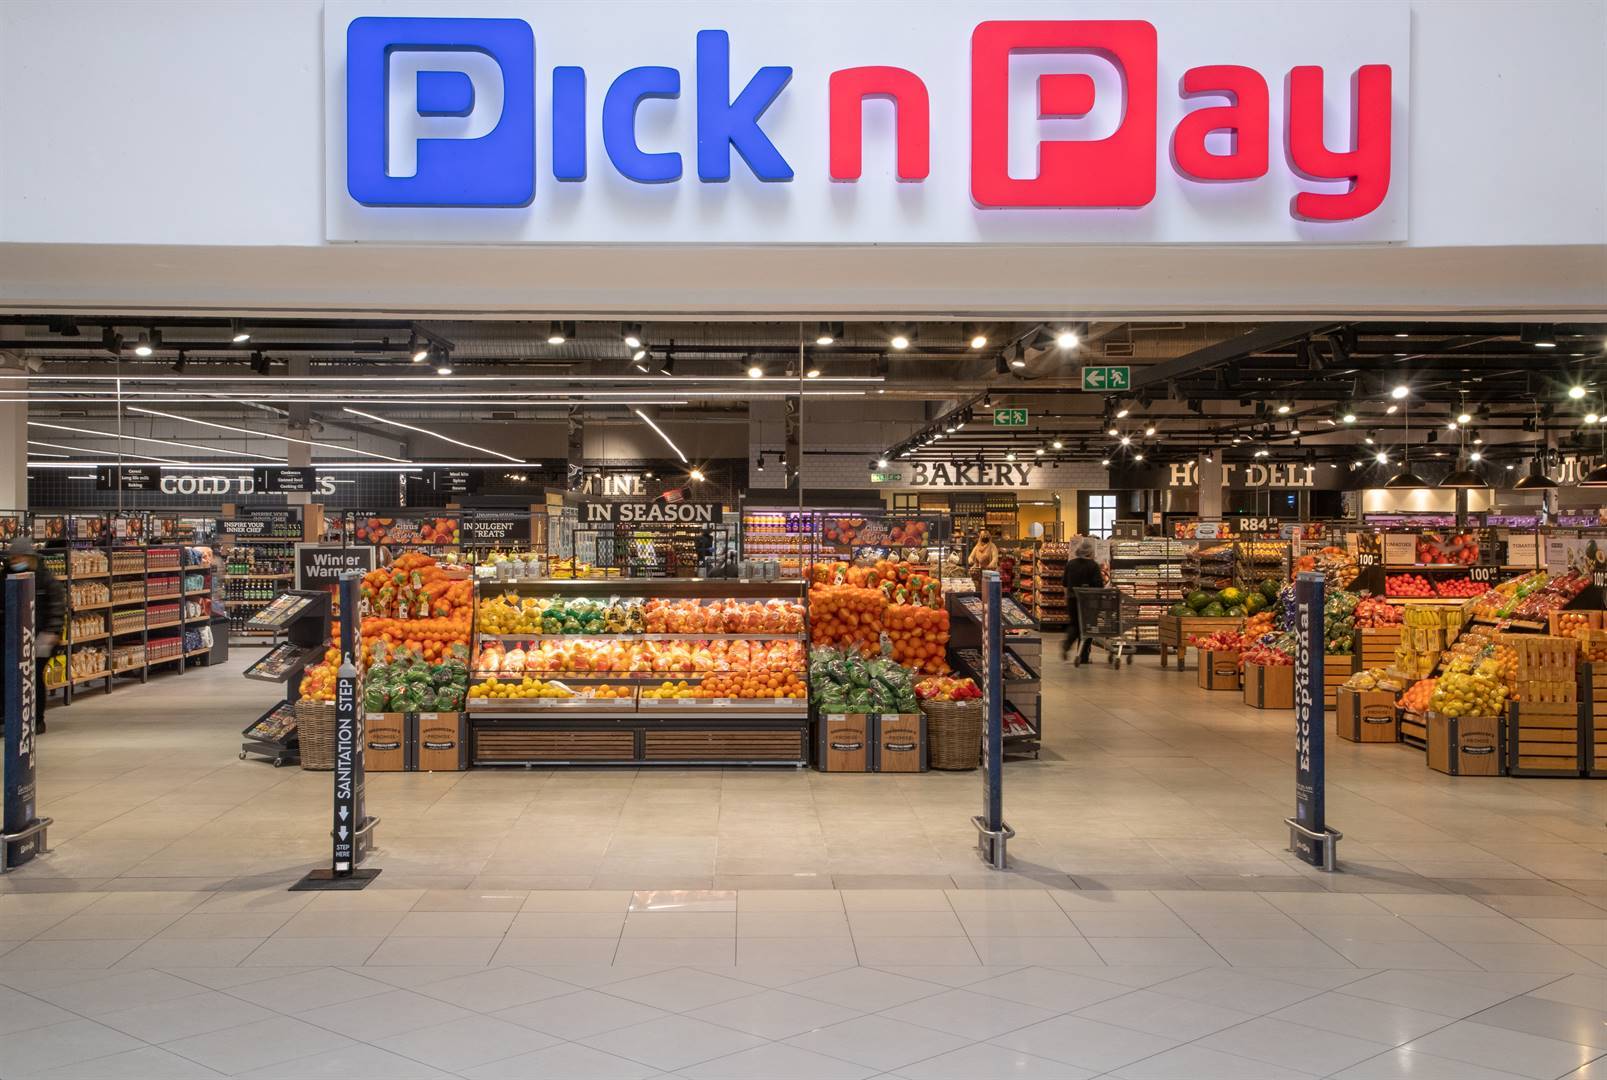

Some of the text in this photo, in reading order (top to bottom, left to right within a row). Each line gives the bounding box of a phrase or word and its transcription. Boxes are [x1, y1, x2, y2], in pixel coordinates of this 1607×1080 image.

[347, 17, 1392, 223] Pick n Pay
[160, 475, 231, 495] COLD
[910, 462, 1033, 486] BAKERY
[1169, 463, 1314, 487] HT DELI
[587, 503, 713, 522] IN SEASON
[463, 522, 514, 530] INDULGENT
[1240, 517, 1267, 531] R84
[313, 553, 360, 566] Winter
[1470, 568, 1489, 581] 100
[19, 626, 32, 757] Everyday
[1300, 601, 1313, 772] Exceptional
[337, 678, 353, 799] SANITATION STEP
